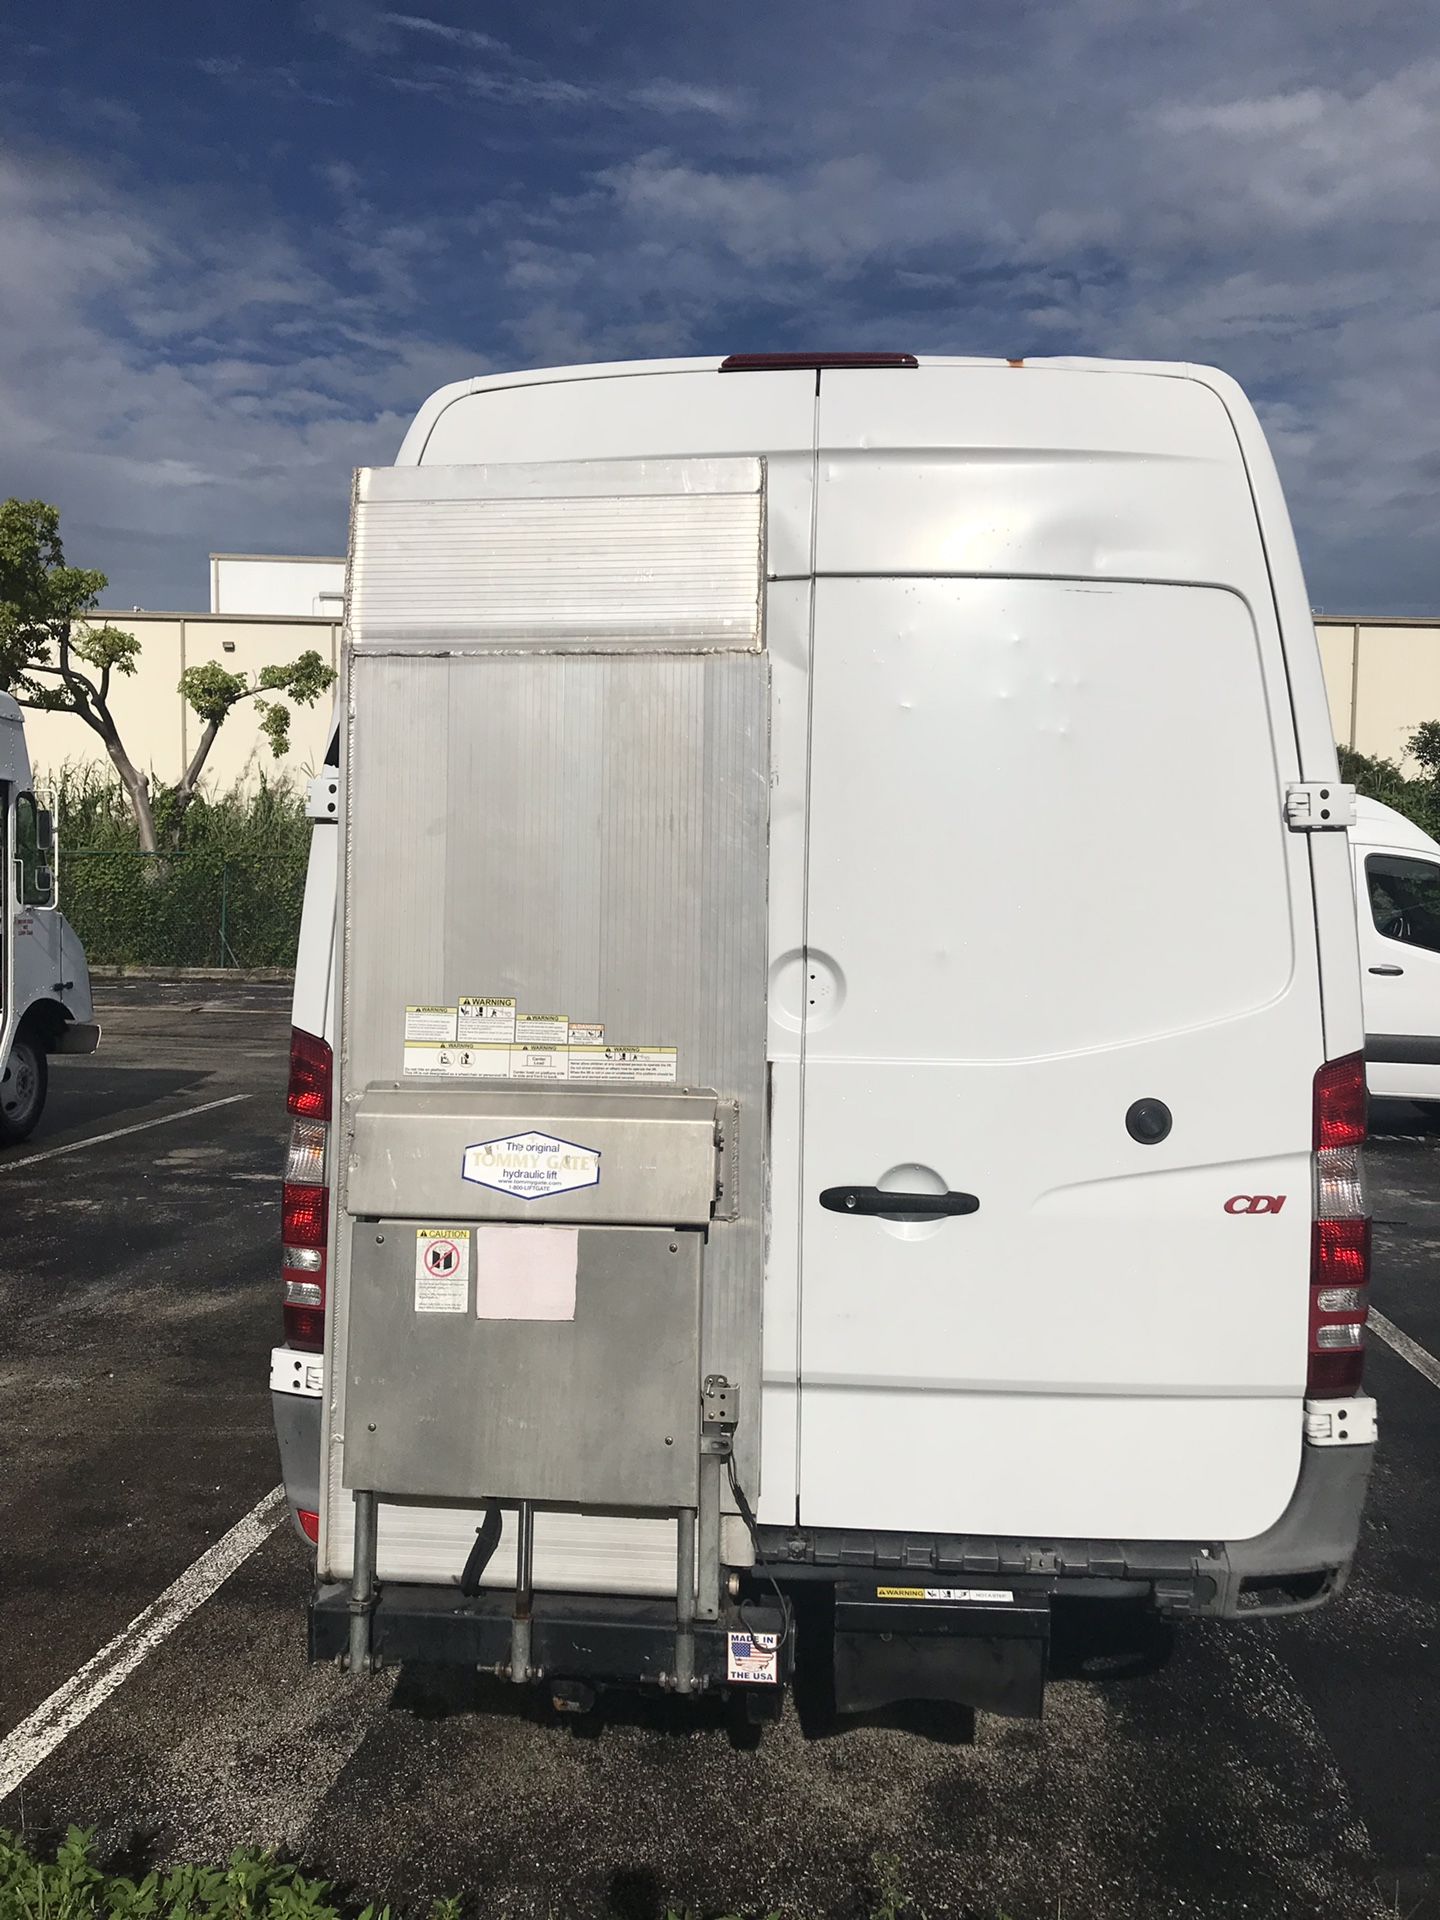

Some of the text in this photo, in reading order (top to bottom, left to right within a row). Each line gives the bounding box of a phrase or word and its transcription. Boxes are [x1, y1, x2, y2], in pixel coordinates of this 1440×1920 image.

[471, 998, 512, 1007] WARNING
[506, 1142, 560, 1154] The original
[472, 1152, 539, 1168] TOMMY
[502, 1168, 558, 1180] hydraulic lift
[1223, 1194, 1287, 1214] CDI
[428, 1230, 467, 1238] CAUTION
[886, 1589, 924, 1597] WARNING
[731, 1634, 774, 1644] MADE IN
[731, 1671, 774, 1681] THE USA
